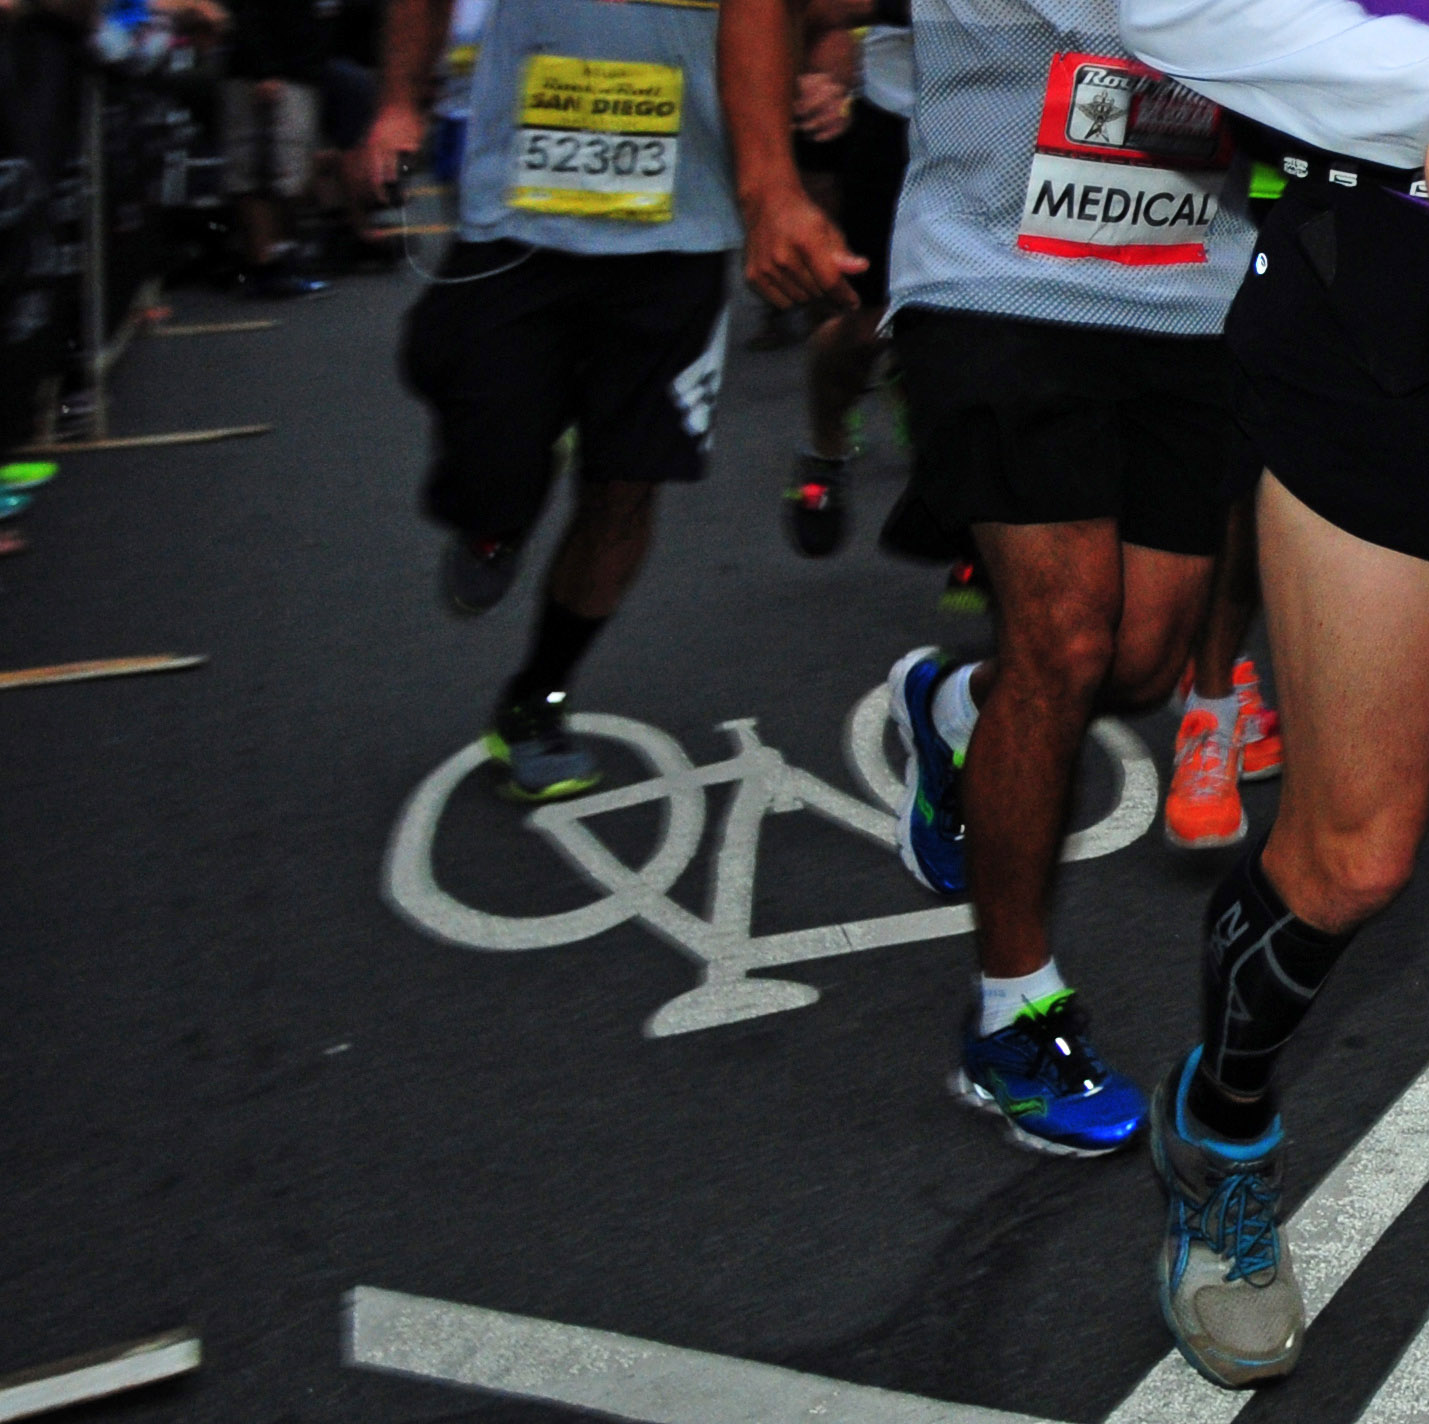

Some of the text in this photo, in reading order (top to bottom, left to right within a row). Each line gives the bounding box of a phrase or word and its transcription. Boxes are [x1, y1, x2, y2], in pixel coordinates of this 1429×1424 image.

[530, 91, 675, 117] SAN DIEGO
[525, 134, 667, 177] 52303
[1031, 179, 1212, 227] MEDICAL
